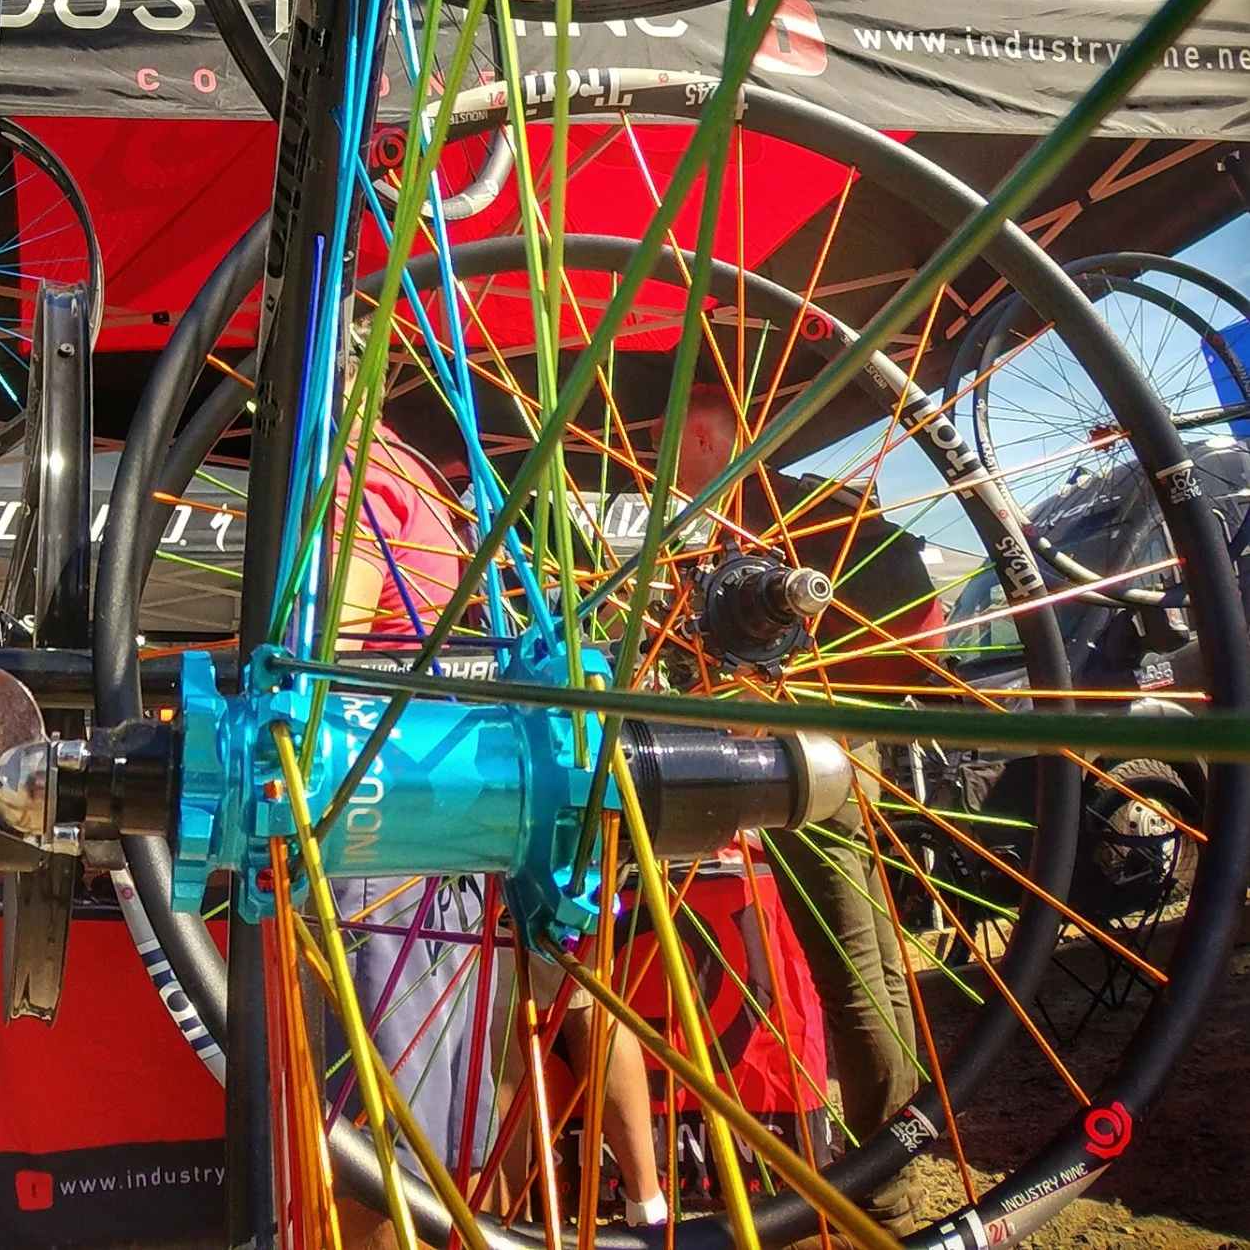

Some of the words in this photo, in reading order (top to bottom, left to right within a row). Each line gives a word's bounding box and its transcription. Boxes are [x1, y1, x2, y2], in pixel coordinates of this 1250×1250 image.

[852, 25, 1250, 72] www.industryne.ne
[342, 696, 385, 866] INDUSRY
[59, 1165, 226, 1197] www.industry
[1000, 1175, 1060, 1214] INDUSTRY
[1060, 1161, 1090, 1186] NINE
